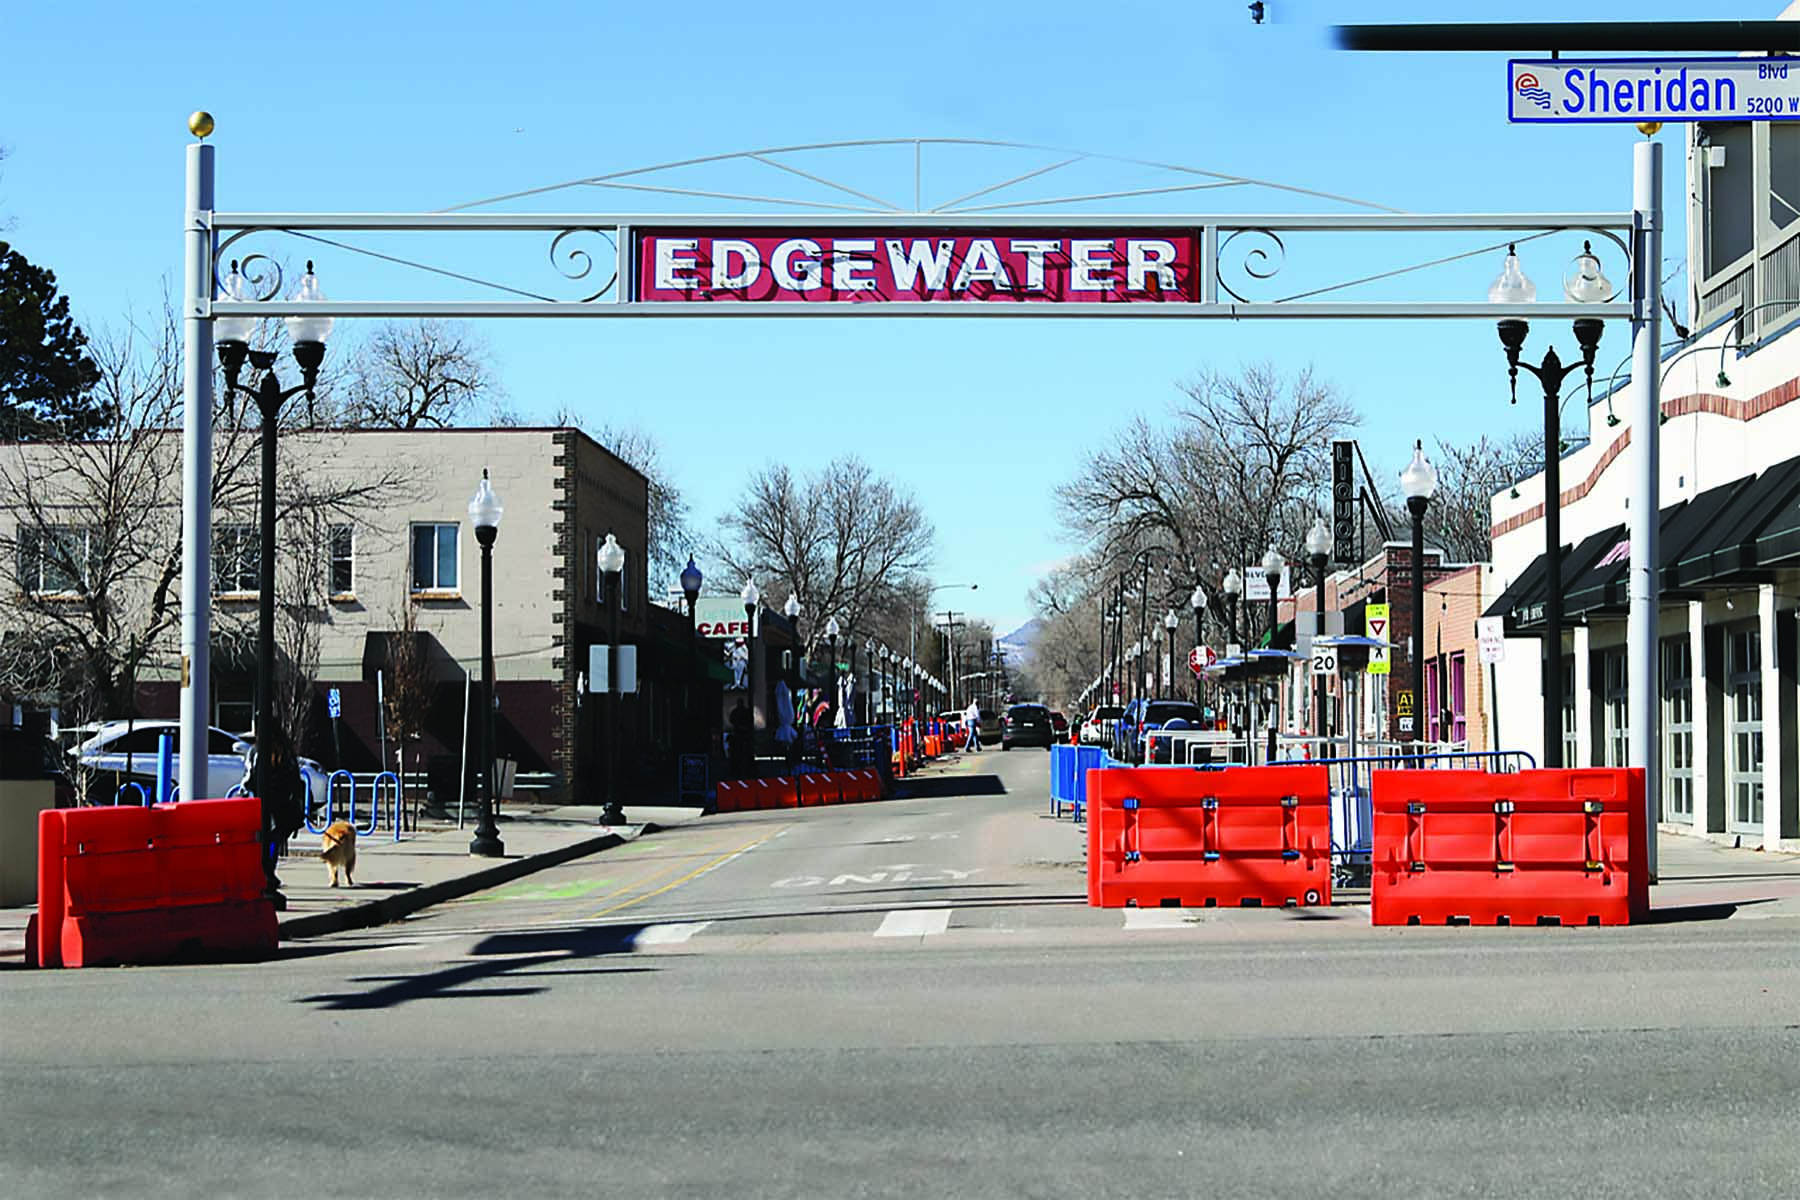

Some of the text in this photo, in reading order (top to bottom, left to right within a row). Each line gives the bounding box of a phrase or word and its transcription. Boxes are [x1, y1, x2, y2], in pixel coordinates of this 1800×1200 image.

[1758, 63, 1788, 80] Blvd
[1562, 67, 1736, 113] Sheridan
[1746, 96, 1800, 114] 5200 W
[653, 238, 1179, 291] EDGEWATER
[1335, 444, 1353, 558] LIQUOR
[697, 621, 749, 636] CAFE
[1313, 655, 1335, 671] 20
